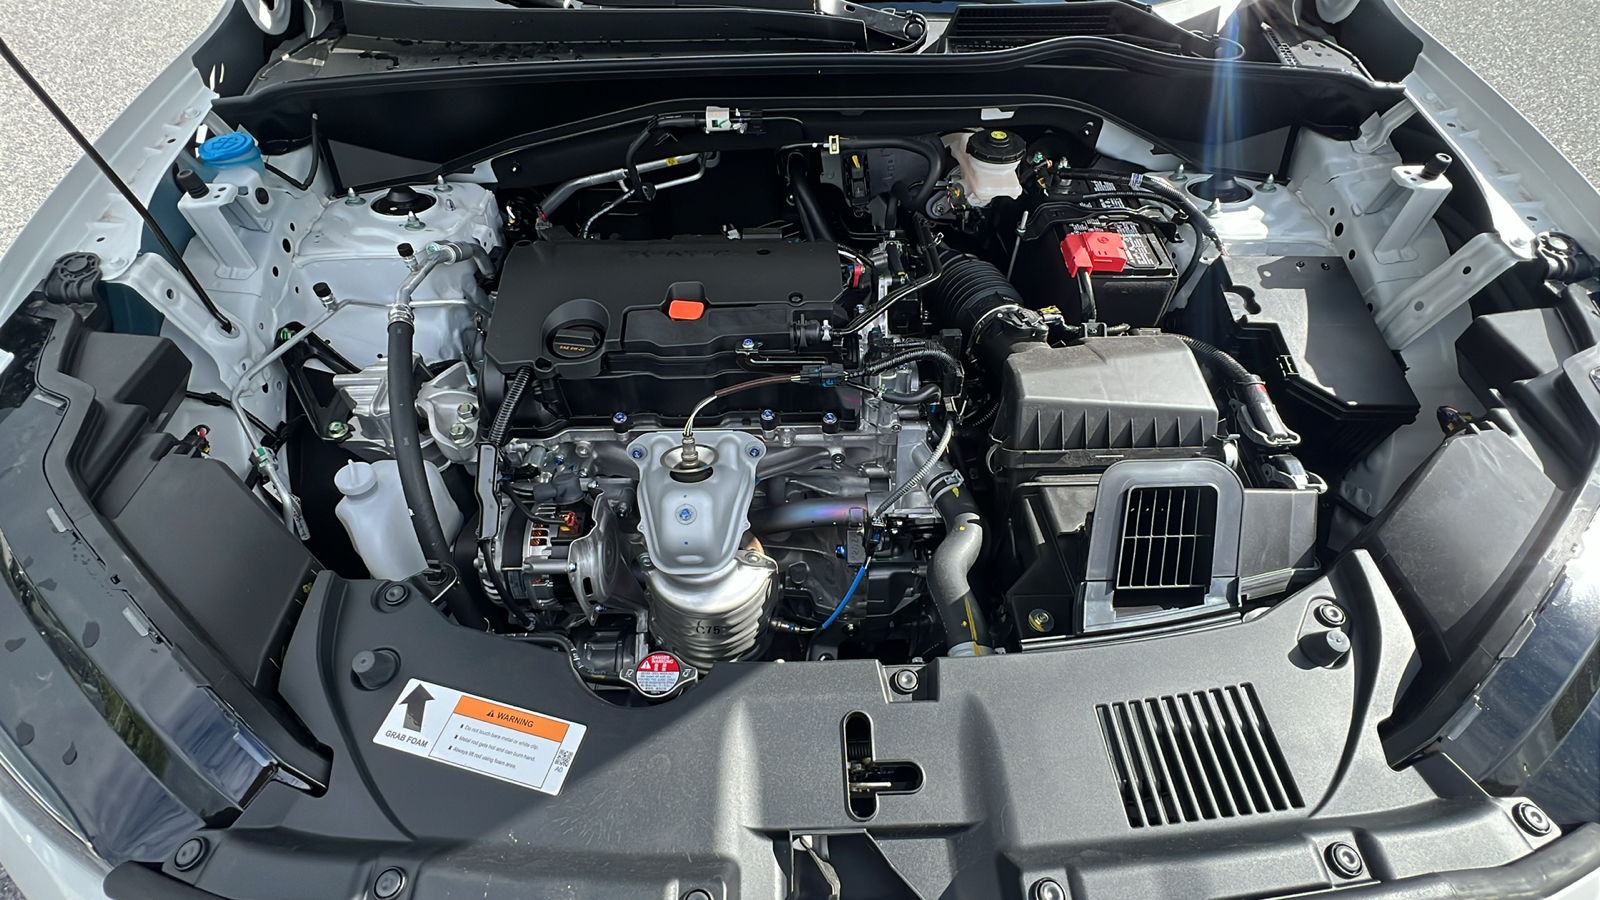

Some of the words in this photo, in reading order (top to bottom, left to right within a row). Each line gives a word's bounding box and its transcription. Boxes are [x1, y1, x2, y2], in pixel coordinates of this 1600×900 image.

[497, 711, 534, 728] WARNING
[385, 729, 406, 742] GRAB
[406, 735, 428, 748] FOAM
[459, 735, 471, 743] Metal
[478, 741, 488, 749] gets
[479, 729, 491, 737] touch
[501, 735, 513, 743] metal
[519, 740, 531, 748] white
[453, 746, 468, 755] Always
[482, 755, 494, 764] using
[494, 758, 506, 766] foam
